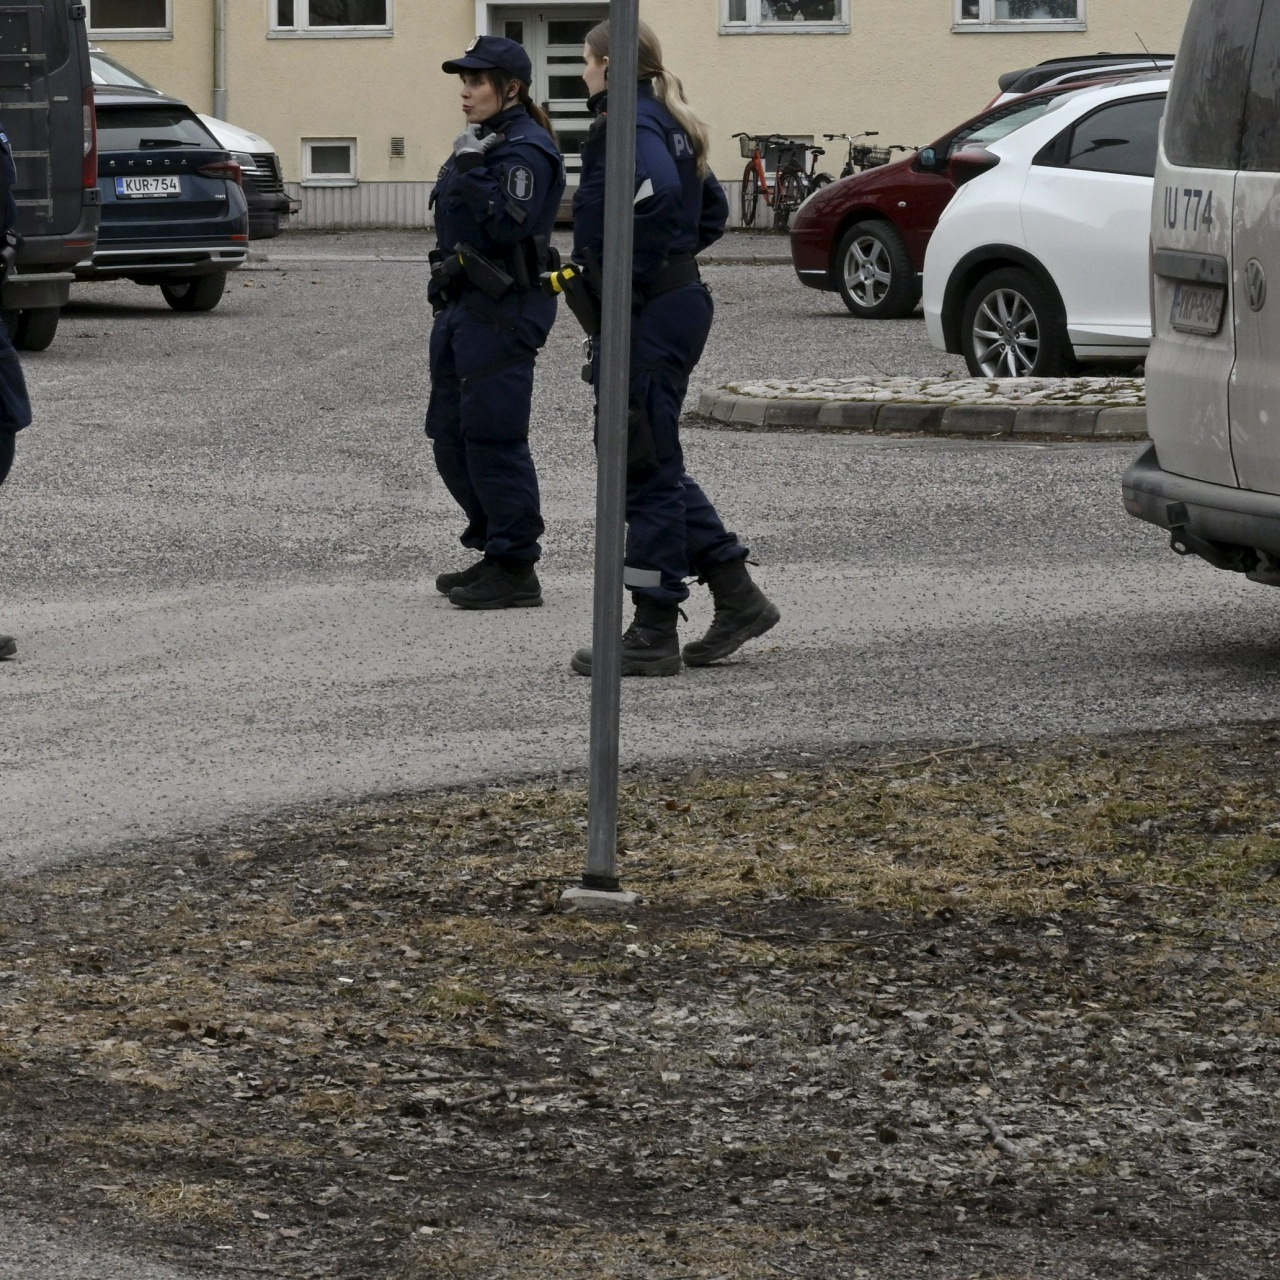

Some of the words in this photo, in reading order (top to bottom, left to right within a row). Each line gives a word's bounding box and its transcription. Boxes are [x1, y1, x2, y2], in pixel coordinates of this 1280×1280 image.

[125, 178, 177, 192] KUR-754
[1163, 186, 1179, 230] IU
[1183, 188, 1213, 233] 774
